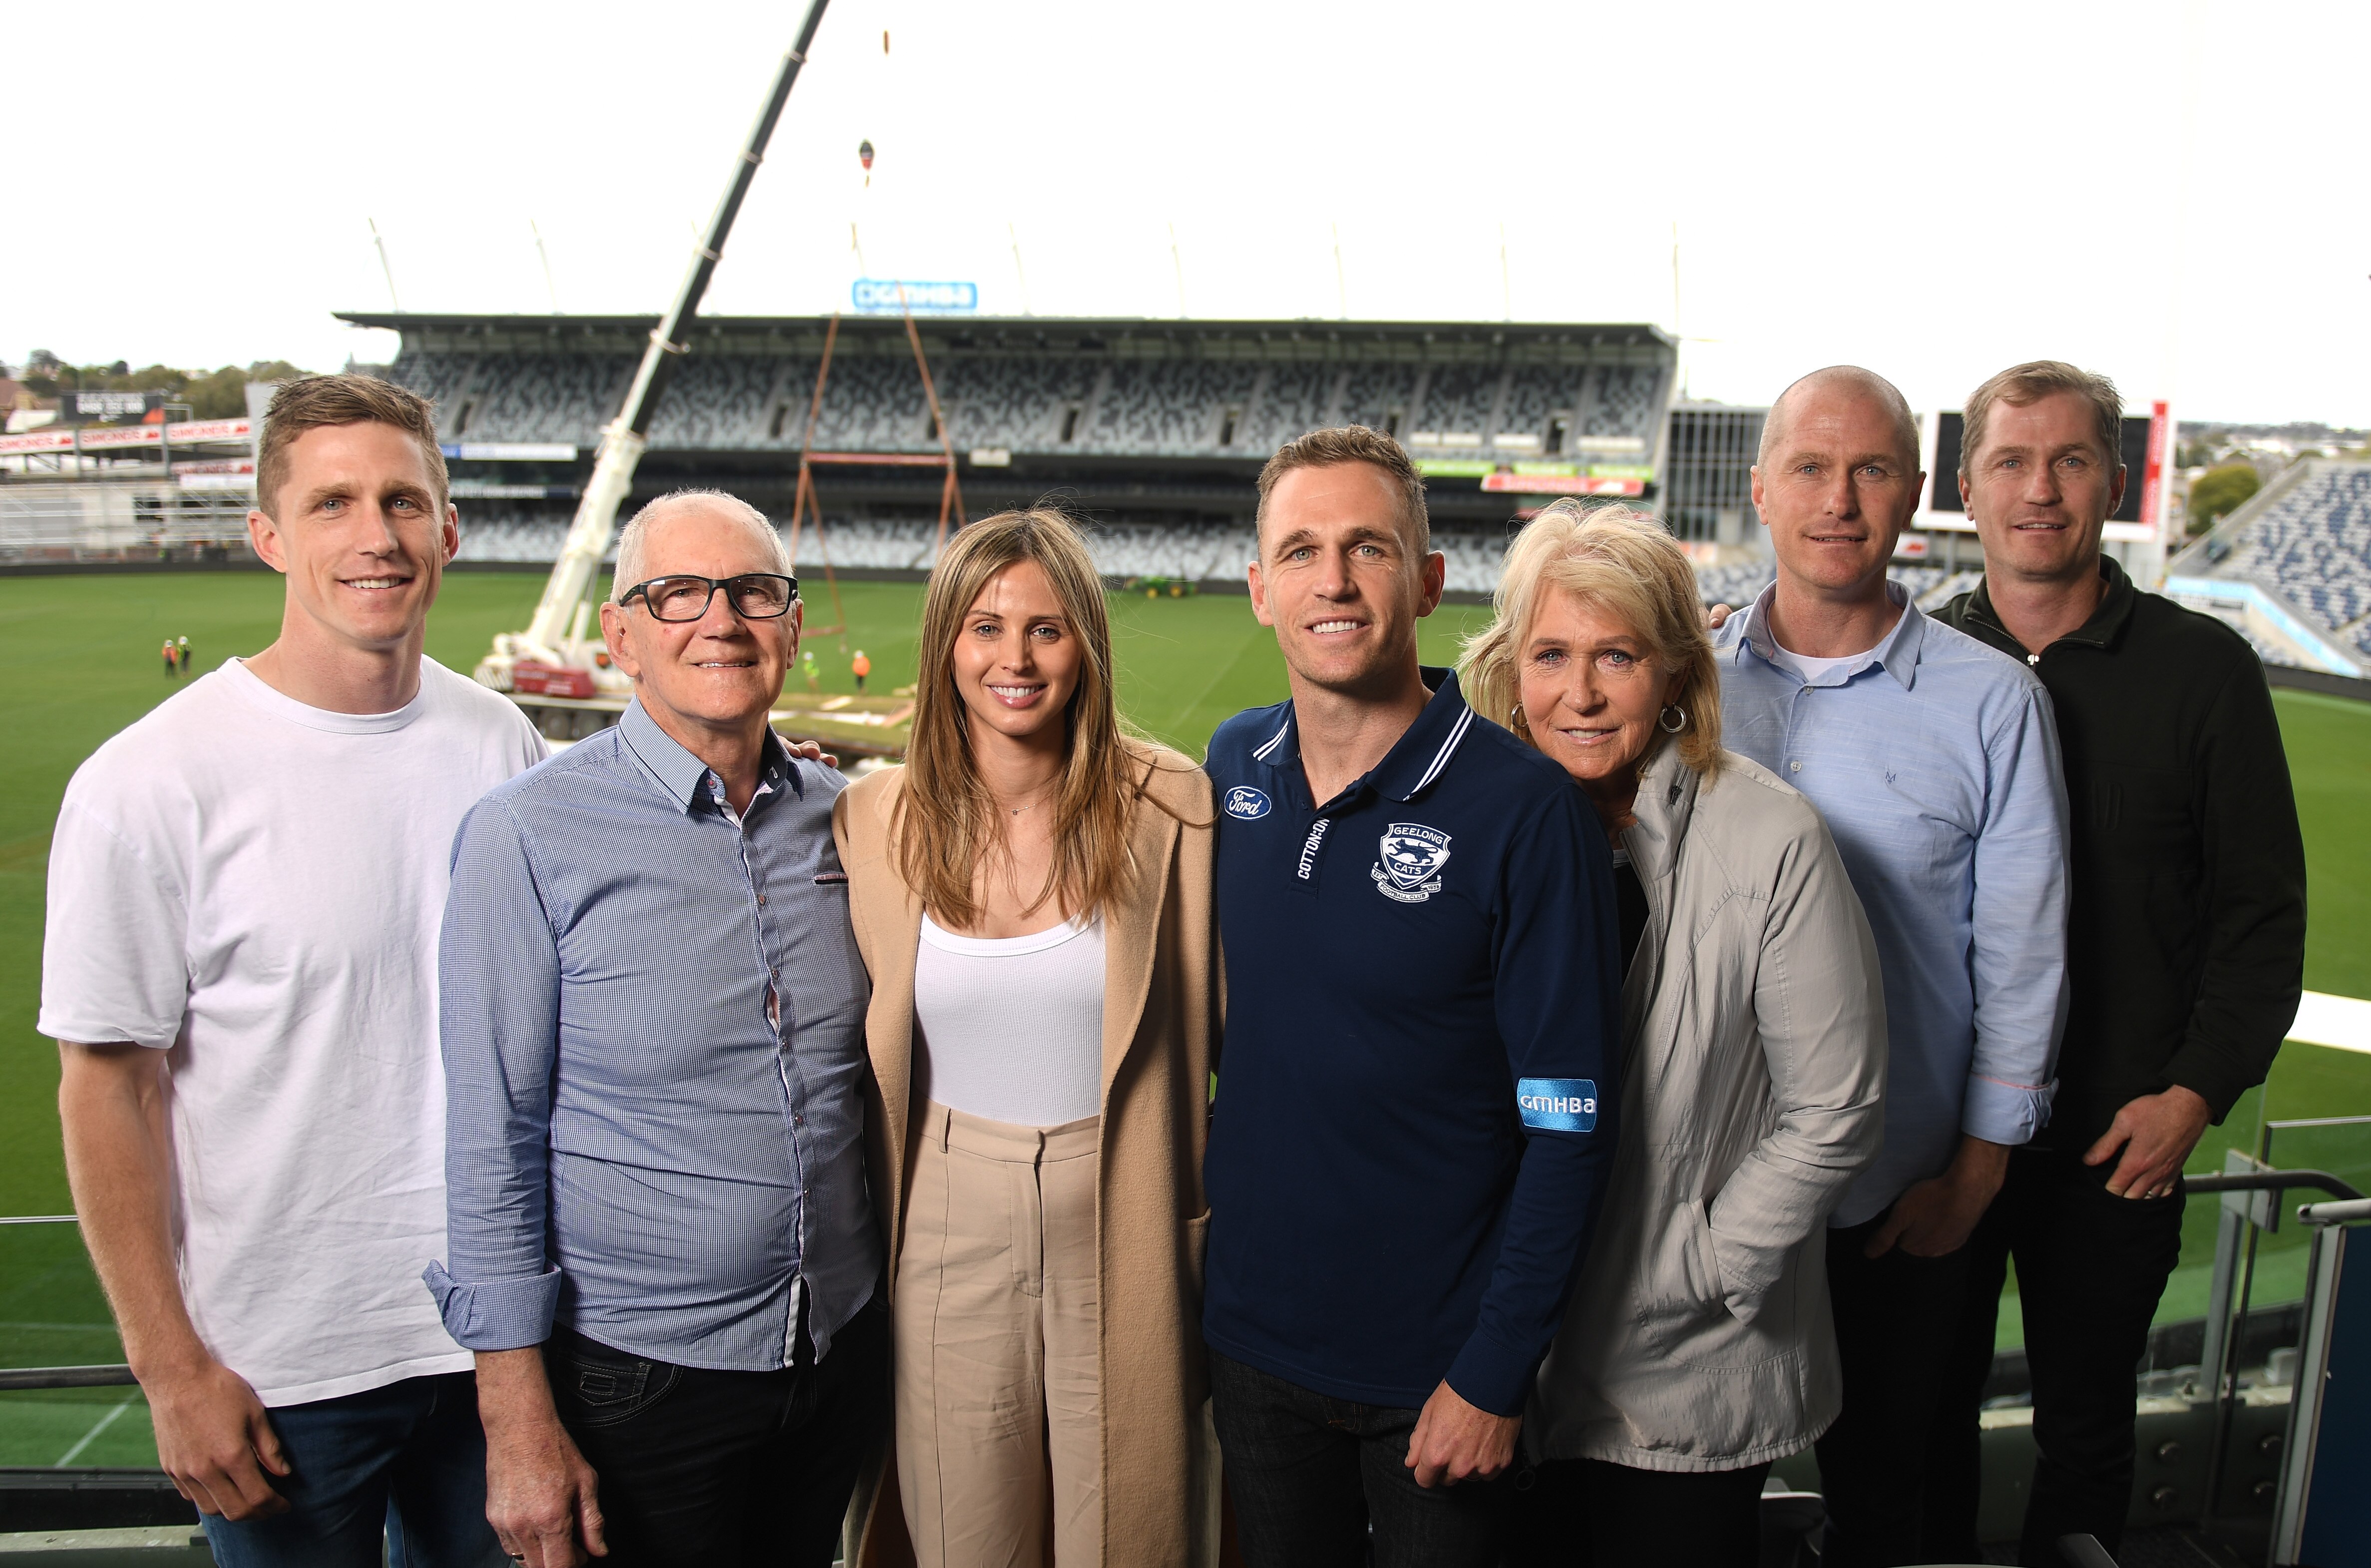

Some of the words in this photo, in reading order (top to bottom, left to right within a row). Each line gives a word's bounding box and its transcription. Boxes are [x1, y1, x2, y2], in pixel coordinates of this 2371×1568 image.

[1229, 790, 1262, 815] Ford
[1394, 827, 1443, 844] GEELONG
[1394, 862, 1422, 874] CATS
[1380, 884, 1408, 899] FOOTBALL
